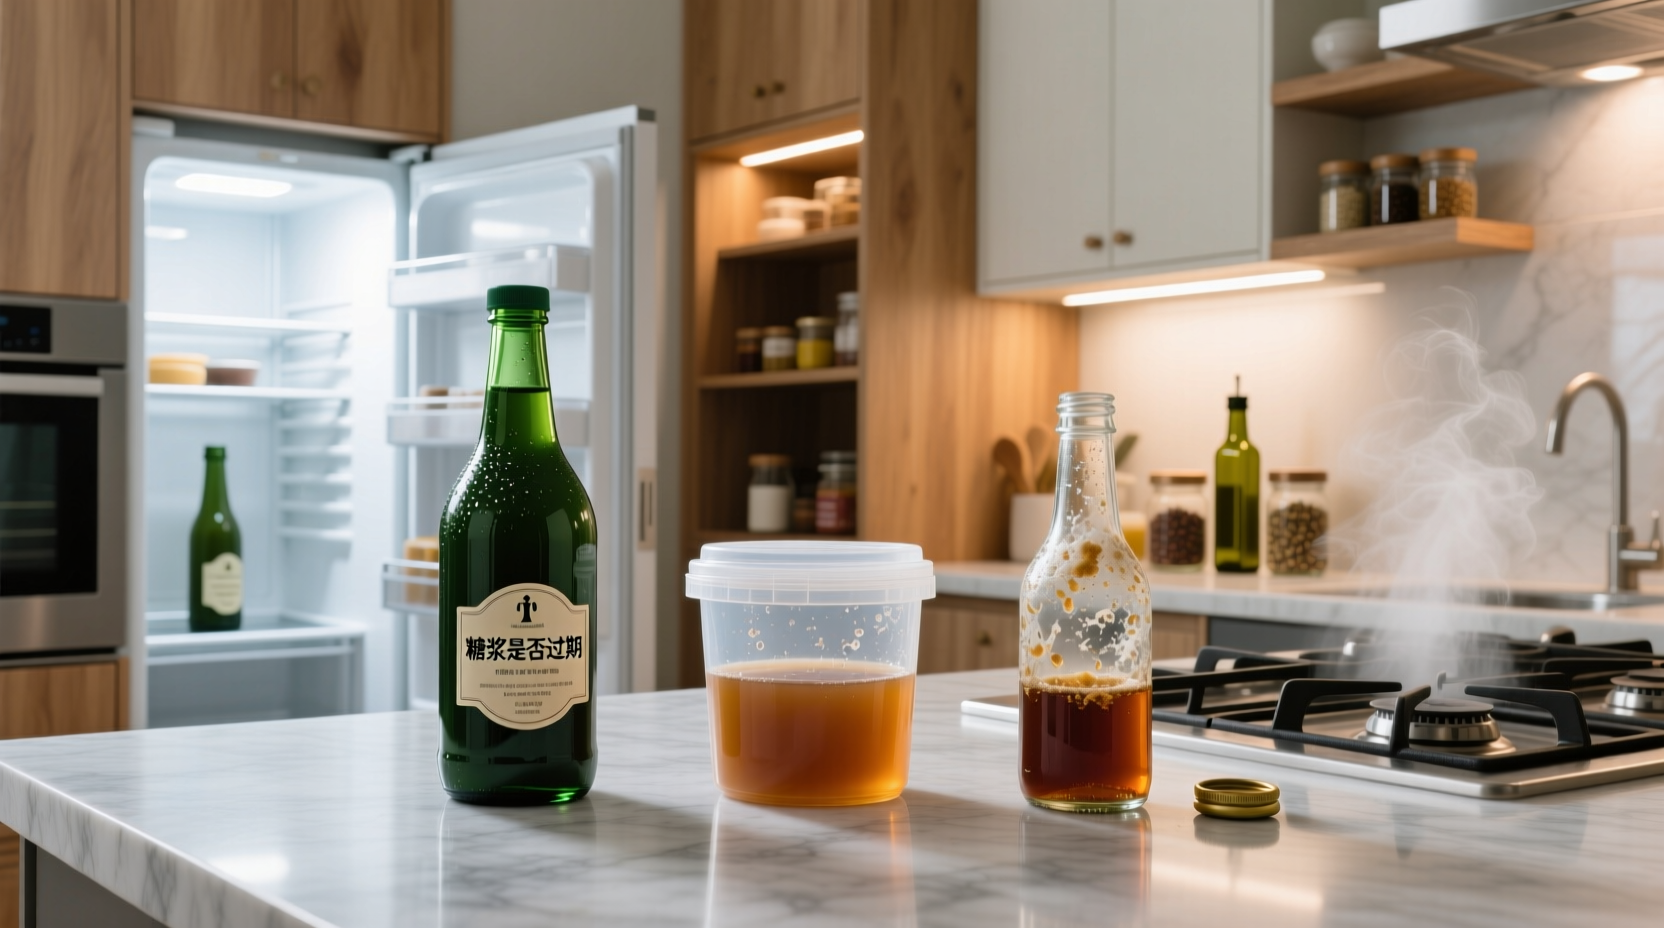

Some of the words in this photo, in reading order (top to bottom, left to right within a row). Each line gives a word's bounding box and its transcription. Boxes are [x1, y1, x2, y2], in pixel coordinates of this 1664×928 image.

[465, 635, 582, 661] 糖浆是否过期
